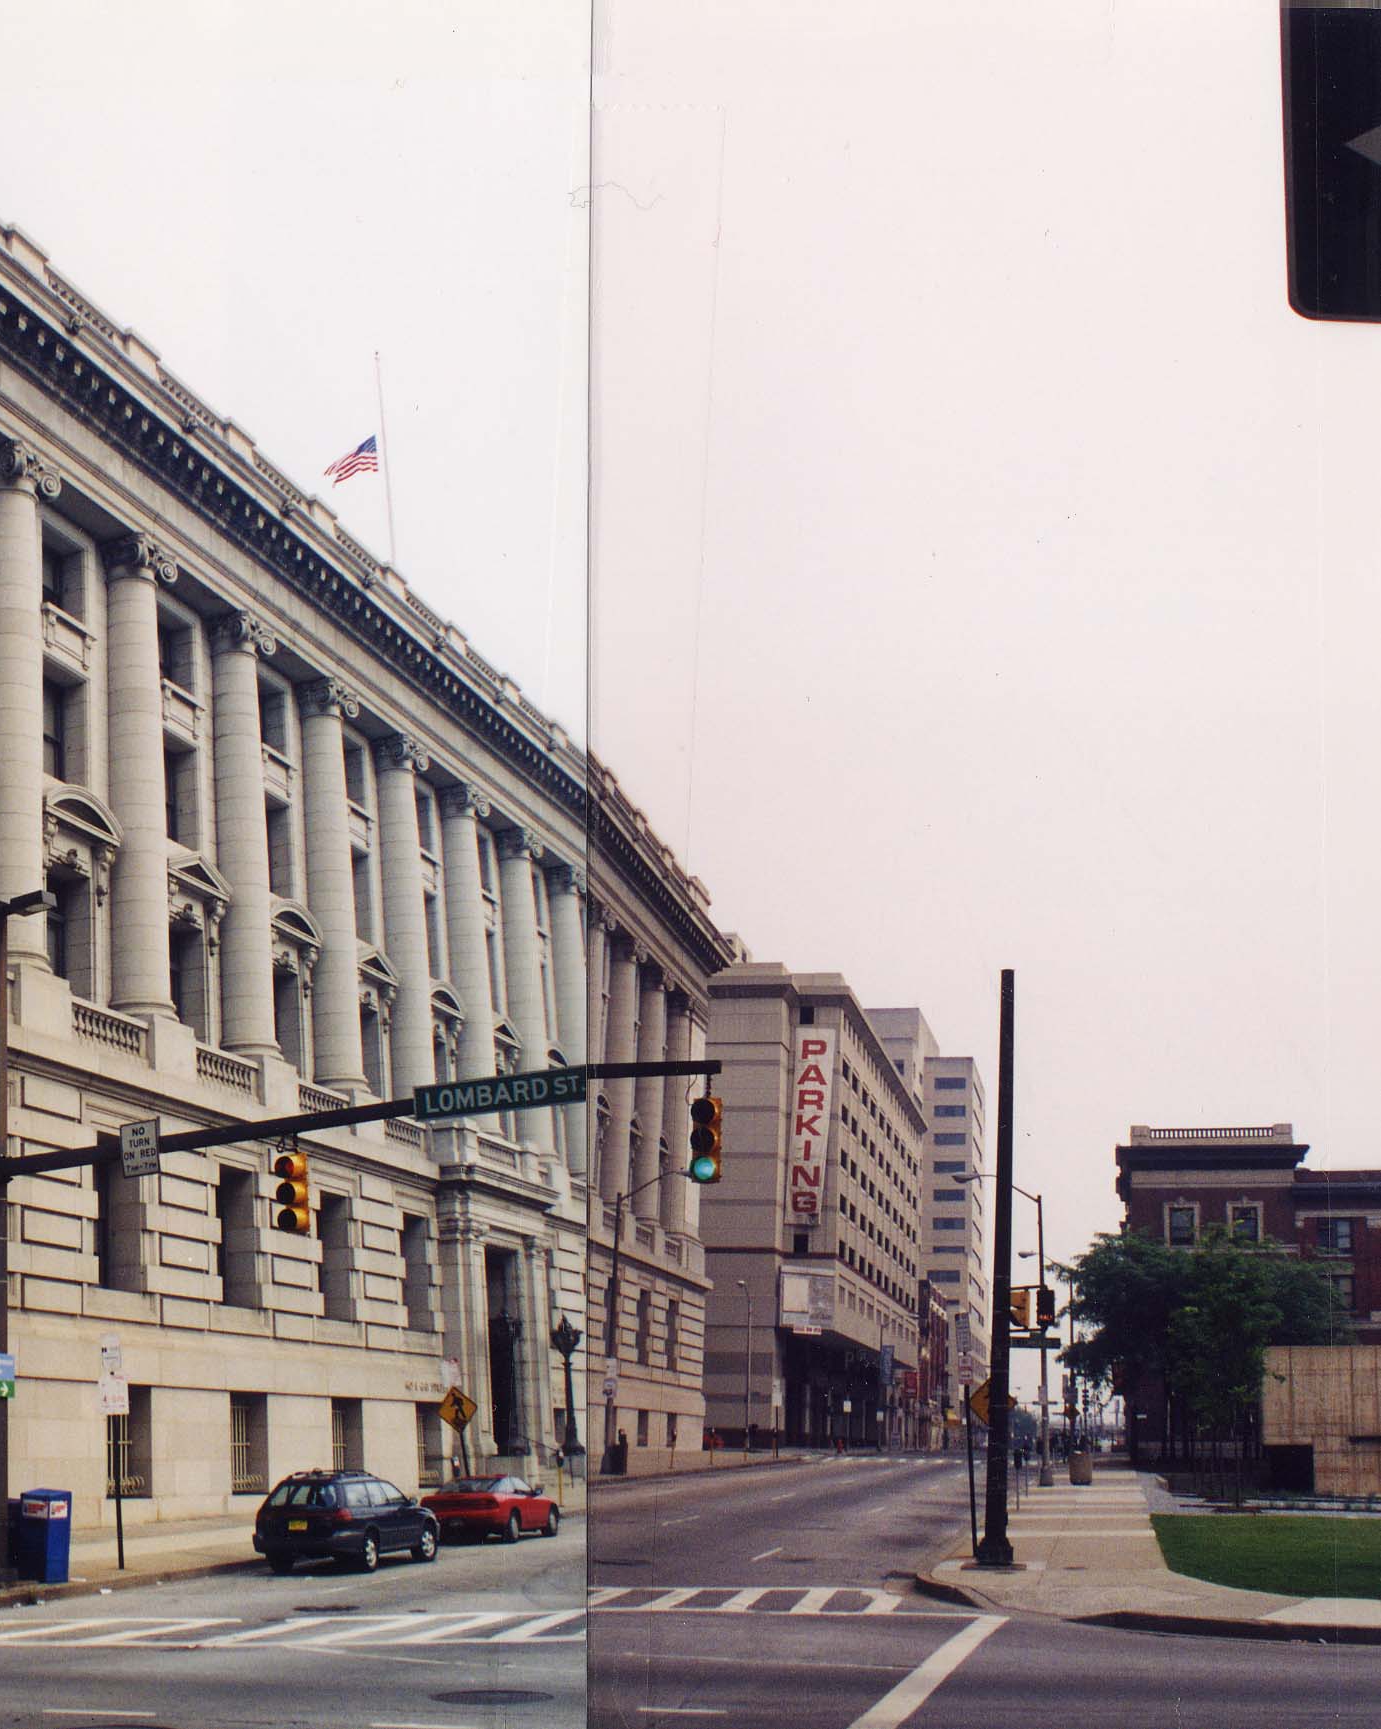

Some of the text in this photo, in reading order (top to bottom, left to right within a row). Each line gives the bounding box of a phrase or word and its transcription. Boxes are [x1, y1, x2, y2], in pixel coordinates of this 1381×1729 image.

[425, 1075, 586, 1113] LOMBARD ST.
[131, 1126, 145, 1137] NO
[791, 1039, 827, 1213] PARKING
[129, 1137, 150, 1148] TURN
[123, 1148, 156, 1160] ON RED
